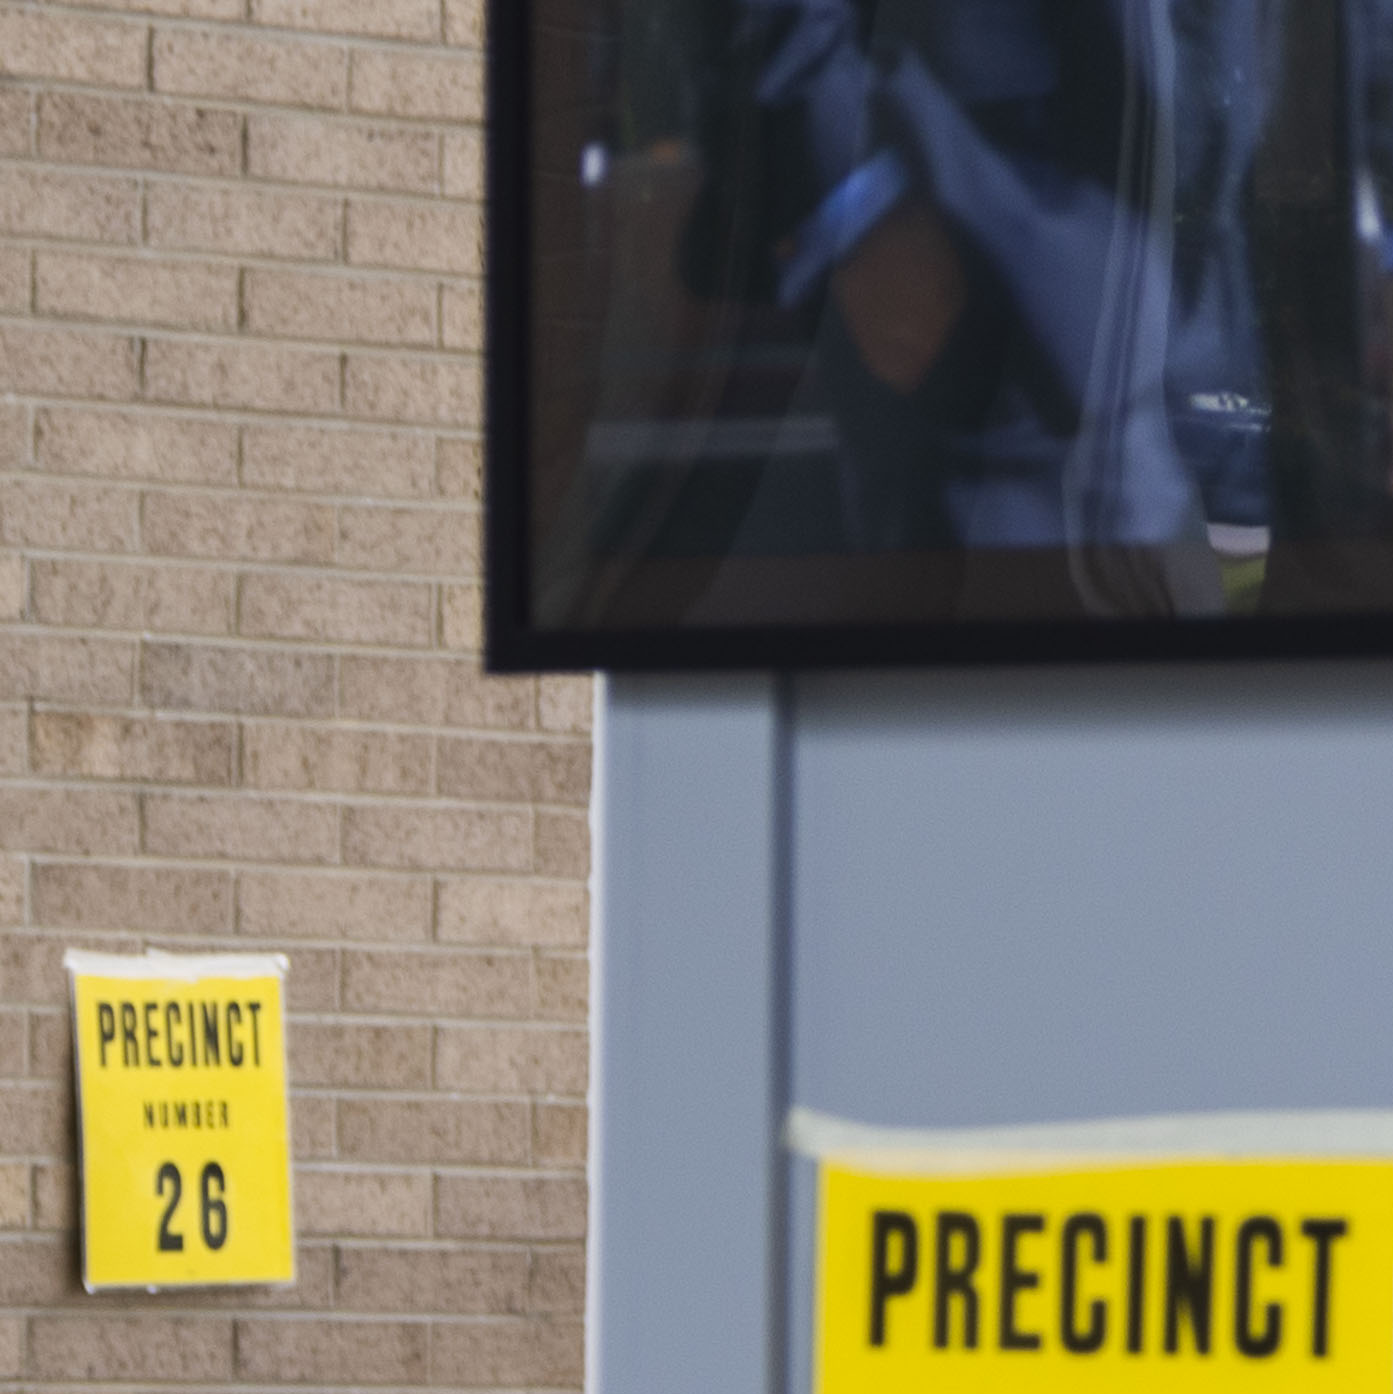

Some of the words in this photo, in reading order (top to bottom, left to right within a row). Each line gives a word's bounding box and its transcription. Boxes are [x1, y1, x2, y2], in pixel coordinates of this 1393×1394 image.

[96, 999, 262, 1068] PRECINCT
[143, 1101, 230, 1131] NUMBER
[155, 1161, 229, 1253] 26
[866, 1208, 1349, 1361] PRECINCT
